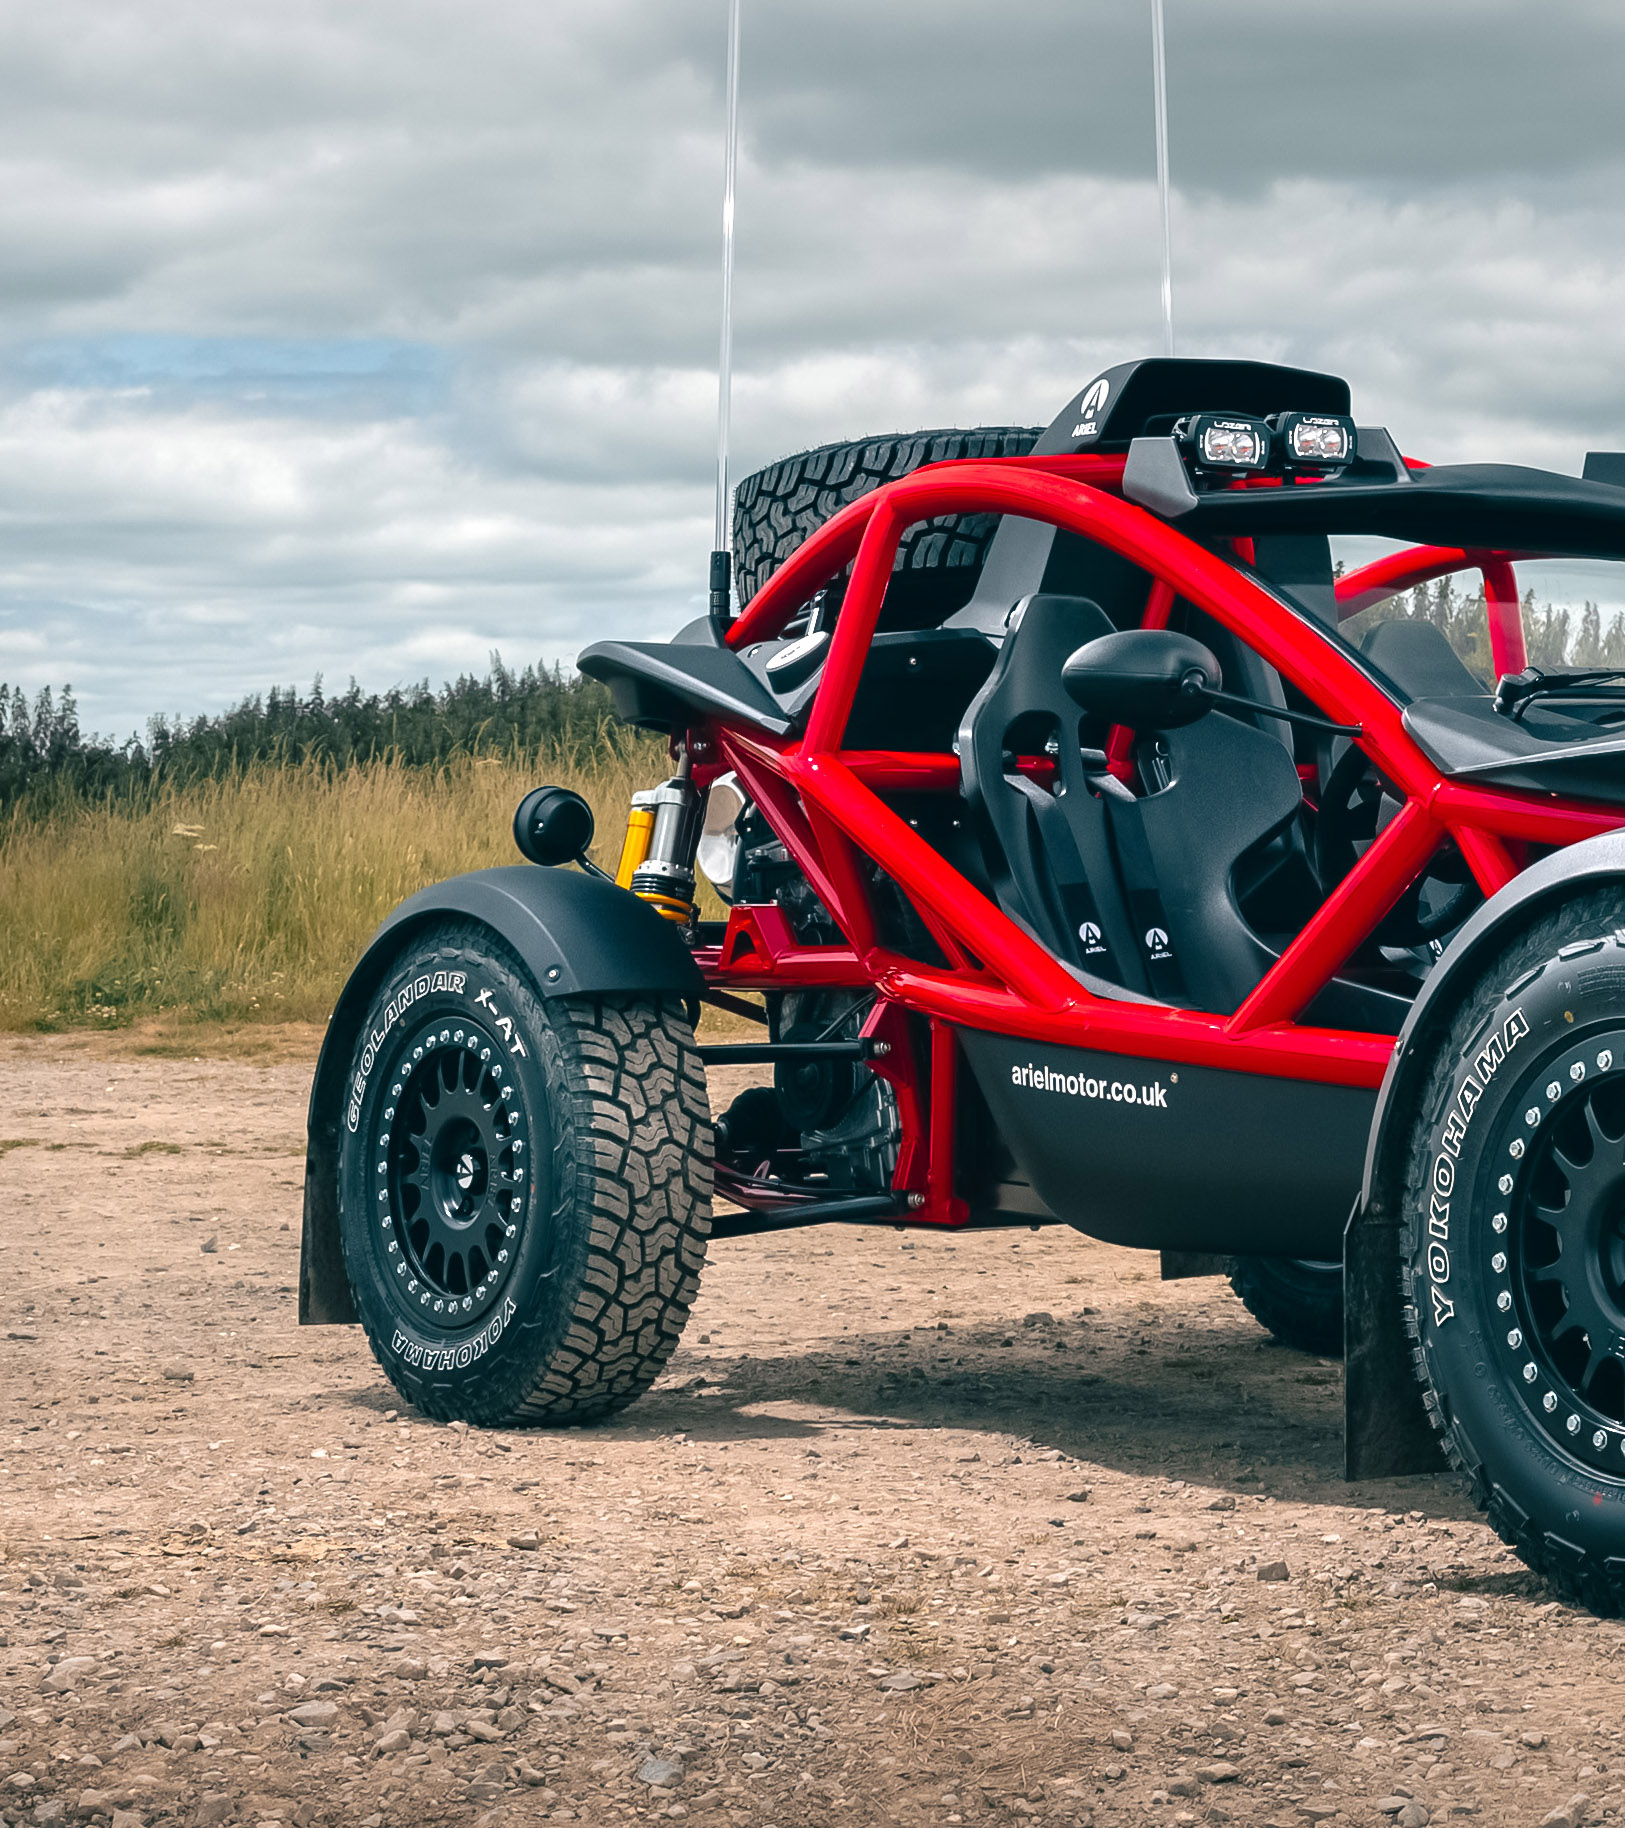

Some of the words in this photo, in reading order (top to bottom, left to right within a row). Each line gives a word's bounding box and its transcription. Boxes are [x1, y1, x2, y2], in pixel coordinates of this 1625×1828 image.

[1071, 421, 1098, 438] ARIEL
[347, 971, 468, 1133] GEOLANDAR
[474, 988, 530, 1058] X-AT
[1011, 1063, 1168, 1108] arielmotor.co.uk
[1428, 1007, 1531, 1327] YOKOHAMA
[391, 1296, 517, 1371] YOKOHAMA
